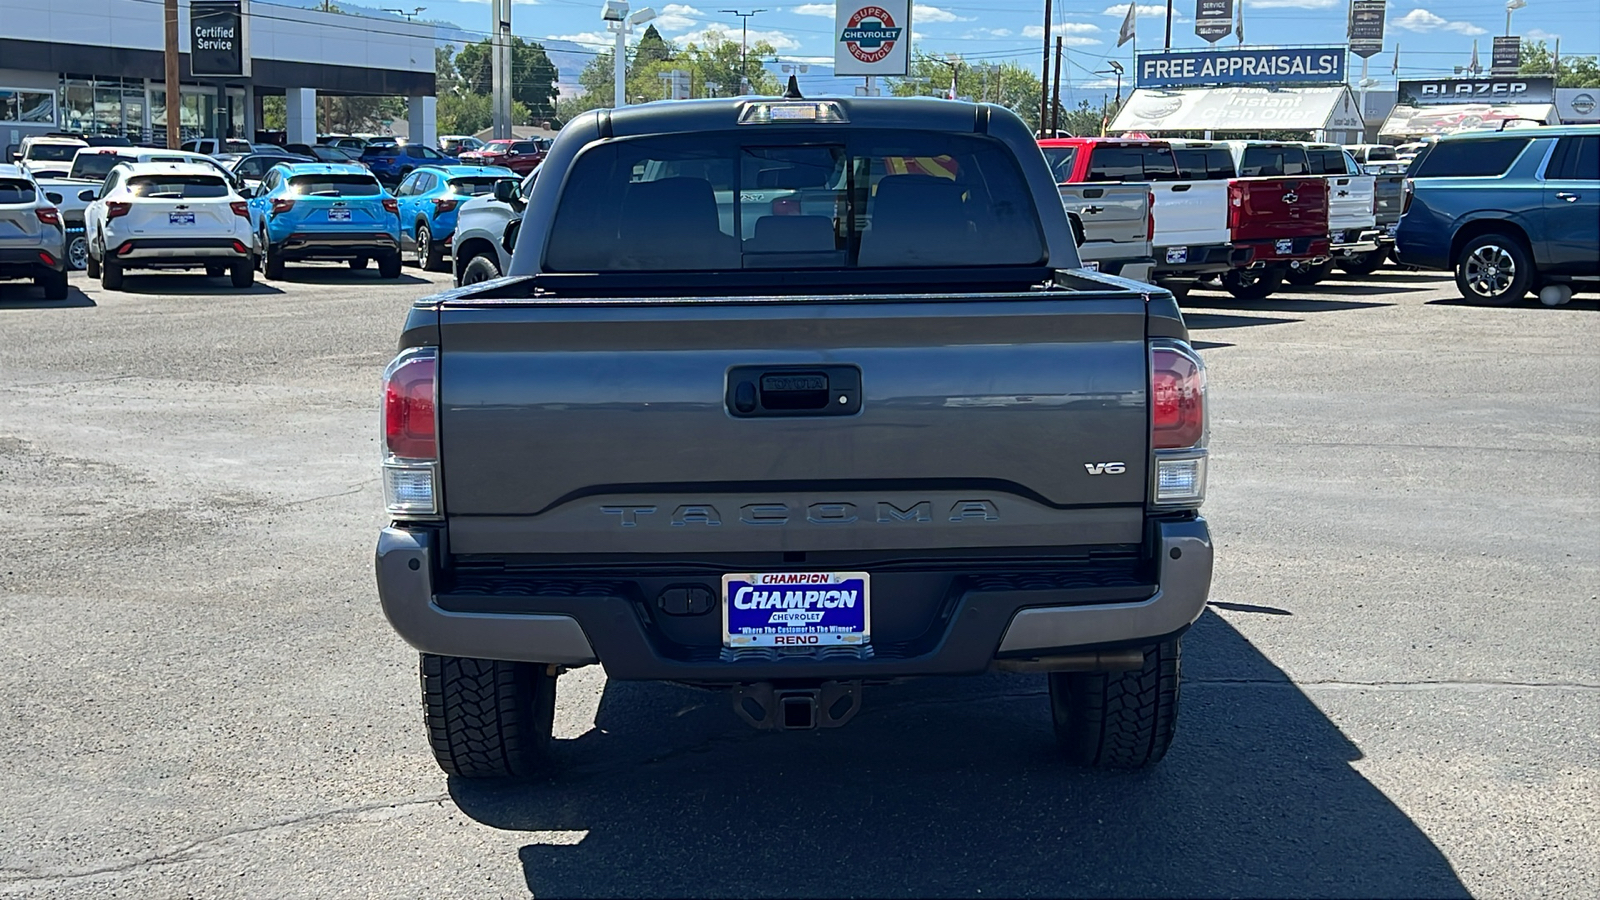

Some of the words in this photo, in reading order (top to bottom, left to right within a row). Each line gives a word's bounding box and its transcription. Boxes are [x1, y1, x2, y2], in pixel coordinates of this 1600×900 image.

[853, 8, 889, 22] SUPER
[195, 26, 234, 38] Certified
[844, 31, 897, 39] CHEVROLET
[197, 38, 232, 50] Service
[849, 44, 891, 62] SERVICE
[1143, 58, 1195, 79] FREE
[1201, 55, 1338, 77] APPRAISALS!
[1421, 82, 1528, 98] BLAZER
[1227, 94, 1303, 107] Instant
[1202, 107, 1255, 120] Cash
[1261, 108, 1316, 120] Offer
[766, 378, 823, 389] TOYOTA
[1084, 461, 1126, 475] V6
[600, 500, 1000, 527] TACOMA
[762, 573, 830, 585] CHAMPION
[734, 586, 857, 610] CHAMPION
[772, 613, 820, 621] CHEVROLET
[764, 626, 777, 634] The
[778, 626, 808, 634] Customer
[774, 635, 819, 645] RENO
